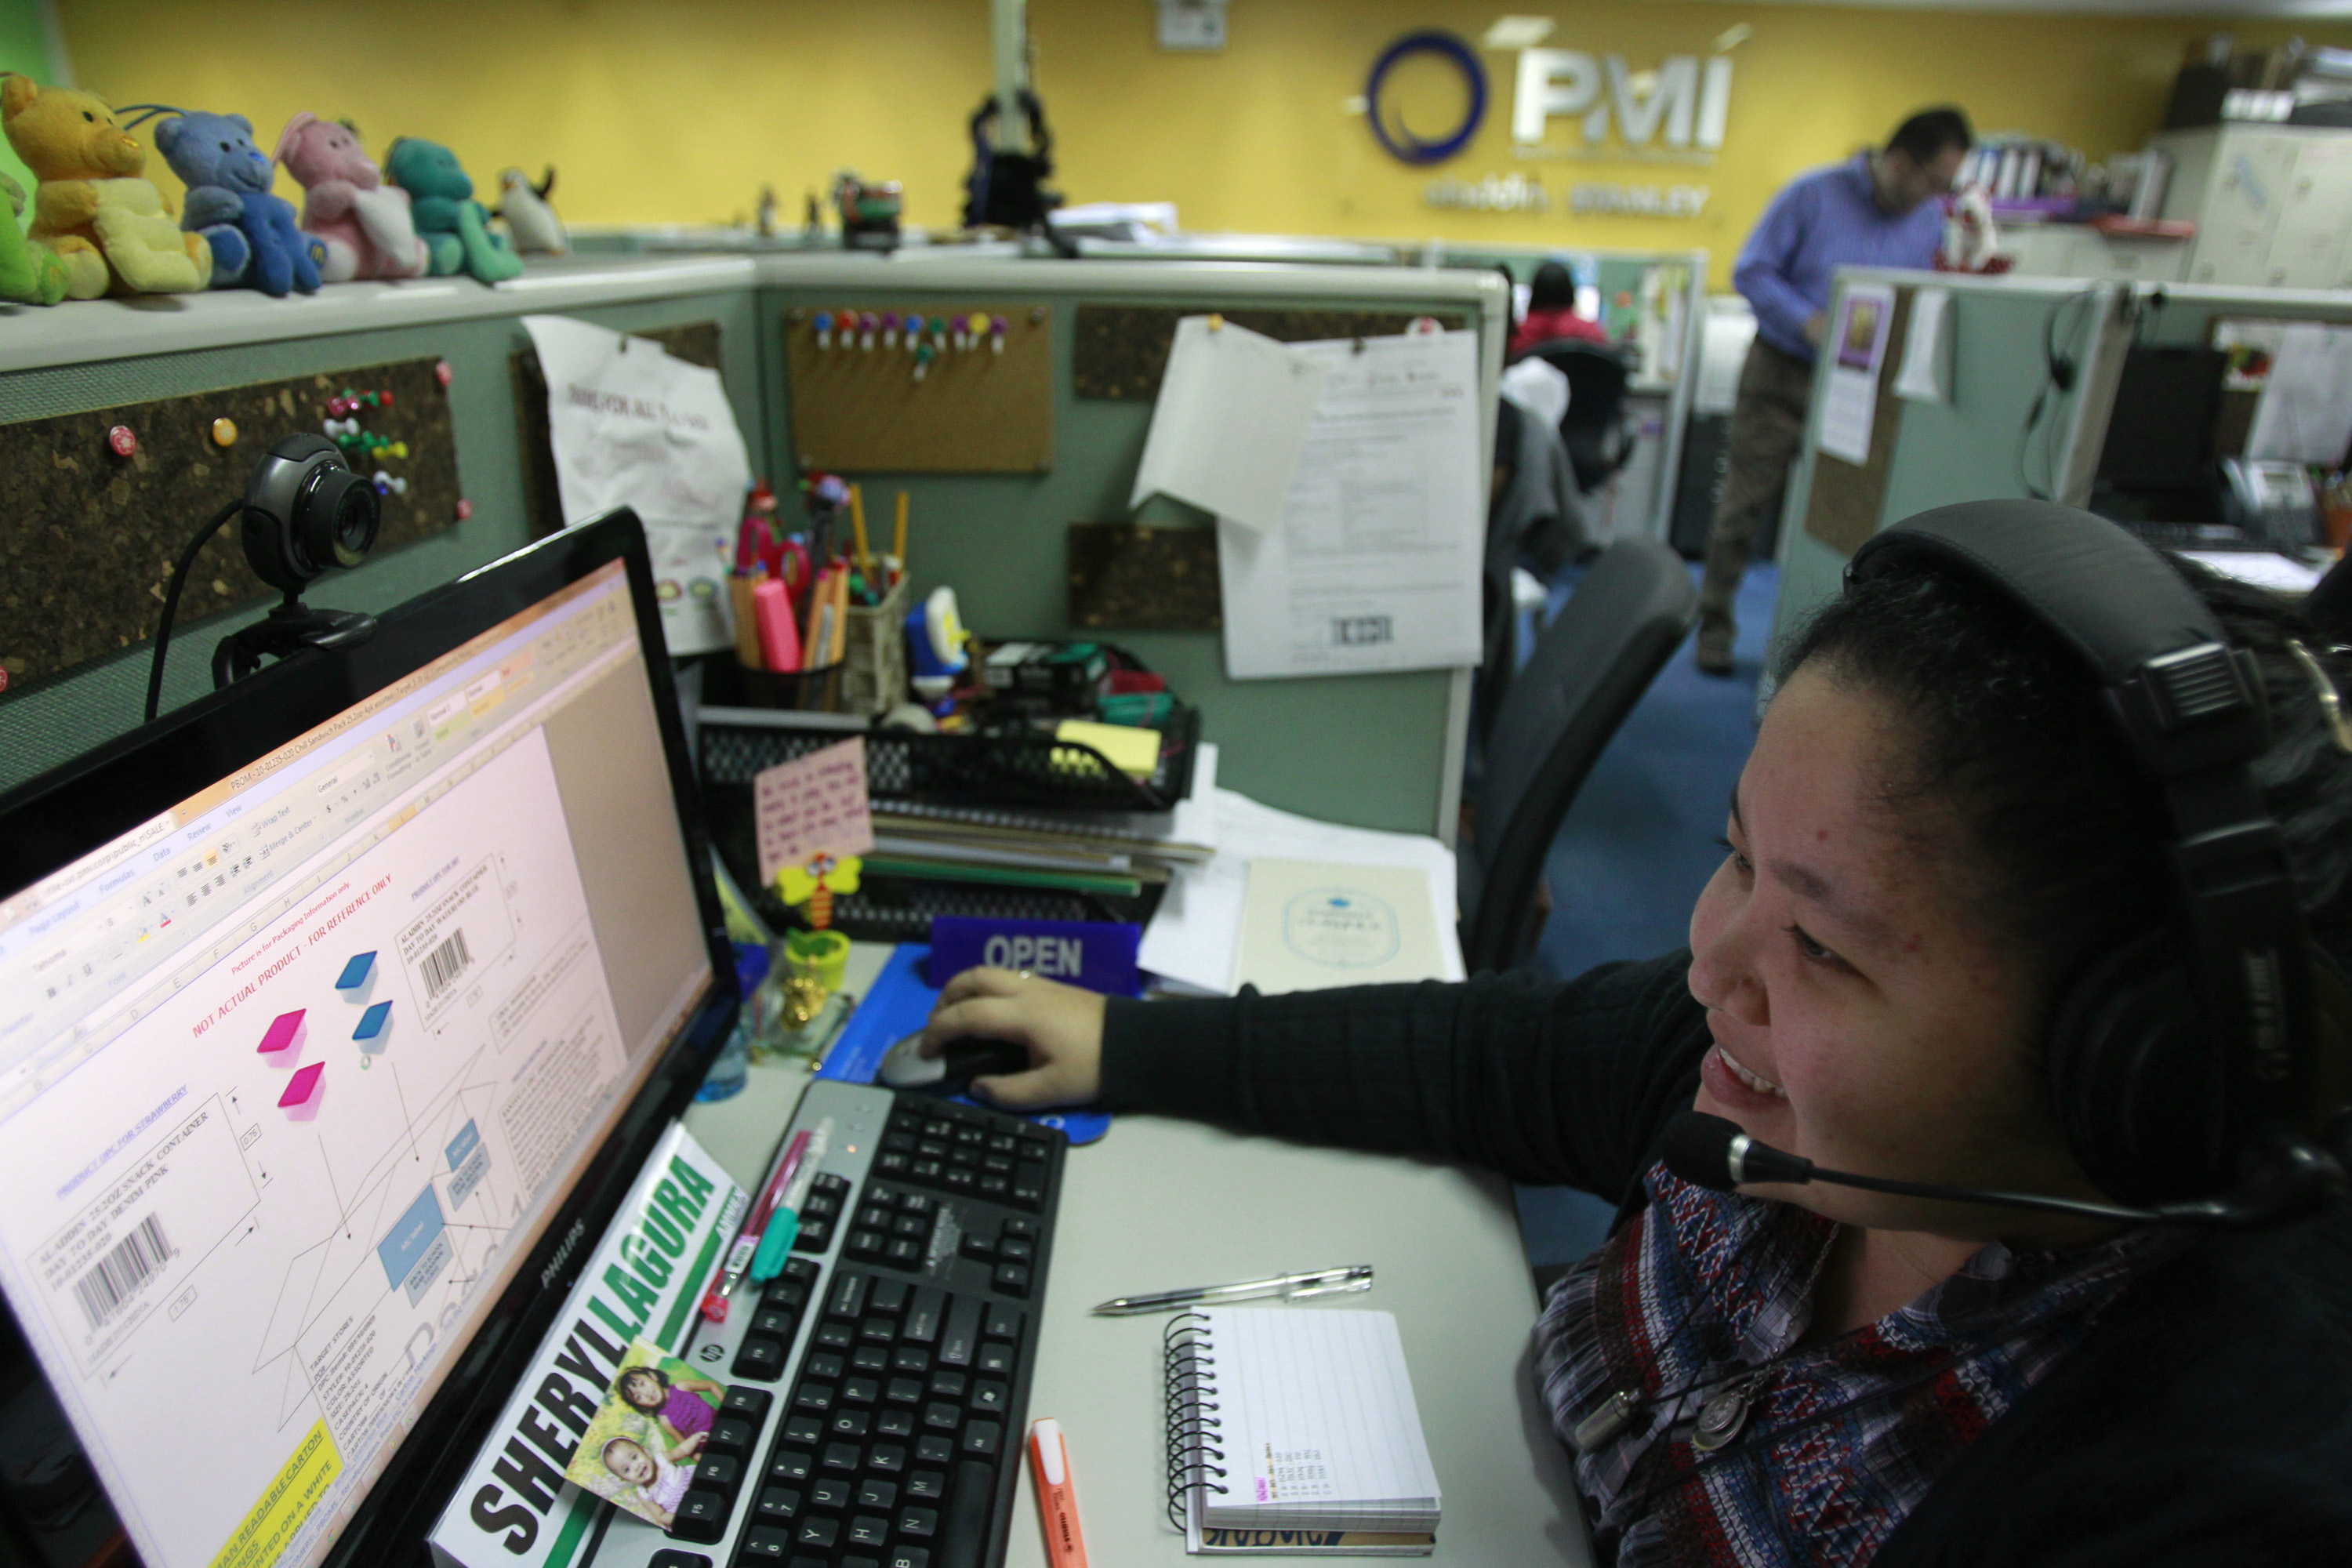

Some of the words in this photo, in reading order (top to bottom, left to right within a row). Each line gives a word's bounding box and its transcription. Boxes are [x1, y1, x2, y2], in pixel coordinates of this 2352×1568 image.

[1512, 48, 1734, 149] PMI
[307, 727, 334, 748] Sandwich
[333, 719, 347, 732] Pack
[317, 775, 339, 794] General
[225, 803, 243, 818] View
[260, 815, 278, 832] Wrap
[278, 805, 291, 818] Text
[187, 821, 212, 841] Review
[268, 836, 289, 853] Merge
[294, 818, 314, 836] Center
[152, 846, 172, 862] Data
[98, 868, 136, 894] Formulas
[243, 869, 275, 895] Alignment
[28, 918, 51, 936] Page
[52, 899, 81, 922] Layout
[230, 953, 256, 976] Picture
[262, 941, 272, 952] for
[271, 917, 304, 945] Packaging
[303, 891, 338, 920] Information
[337, 881, 352, 896] only.
[400, 917, 425, 946] ALADDIN
[32, 948, 68, 974] Tahoma
[191, 1012, 216, 1039] NOT
[217, 982, 258, 1019] ACTUAL
[257, 944, 303, 987] PRODUCT
[307, 926, 327, 946] FOR
[327, 890, 372, 931] REFERENCE
[371, 872, 392, 897] ONLY
[402, 942, 416, 956] DAY
[984, 936, 1084, 977] OPEN
[117, 1129, 136, 1149] FOR
[135, 1083, 189, 1134] STRAWBERRY
[39, 1218, 87, 1265] ALADDIN
[122, 1158, 156, 1192] SNACK
[155, 1110, 209, 1161] CONTAINER
[44, 1256, 67, 1279] DAY
[68, 1239, 87, 1257] TO
[86, 1219, 110, 1243] DAY
[110, 1185, 145, 1221] DENIM
[143, 1161, 171, 1191] PINK
[540, 1216, 586, 1290] PHILIPS
[310, 1341, 332, 1371] TARGET
[332, 1315, 354, 1344] STORES
[699, 1343, 726, 1363] hp
[347, 1345, 375, 1383] ASSORTED
[339, 1406, 364, 1441] COUNTRY
[347, 1427, 369, 1460] CARTON
[238, 1479, 288, 1546] READABLE
[285, 1428, 323, 1482] CARTON
[280, 1509, 297, 1533] ON
[303, 1459, 333, 1501] WHITE
